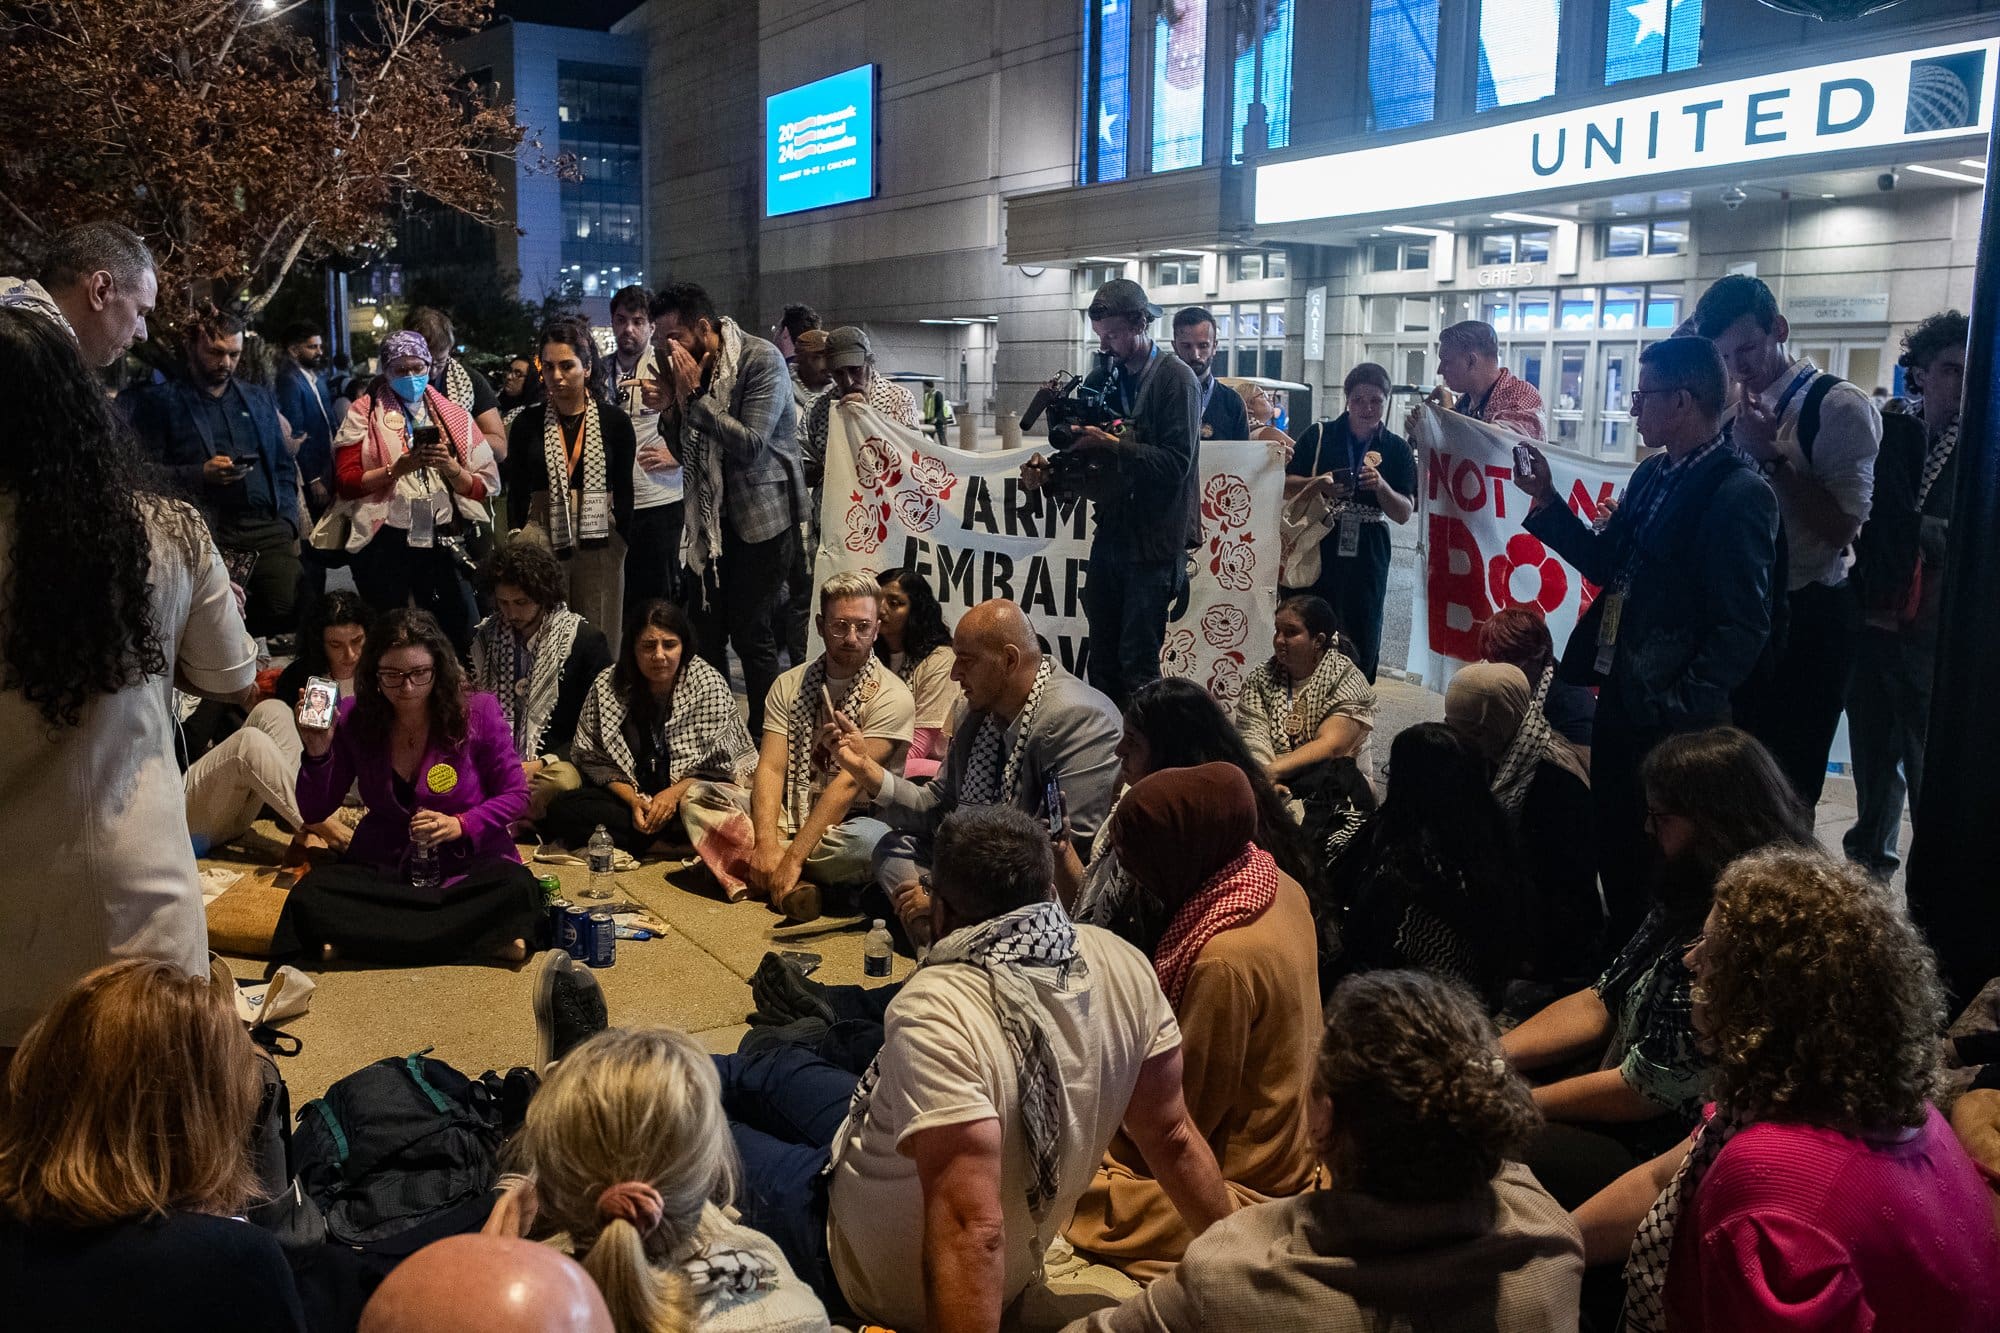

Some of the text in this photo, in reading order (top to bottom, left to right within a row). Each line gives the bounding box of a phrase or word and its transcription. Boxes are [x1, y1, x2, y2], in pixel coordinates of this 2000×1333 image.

[1532, 78, 1875, 176] UNITED
[1478, 267, 1534, 286] GATE 3
[1310, 294, 1321, 355] GATE 3
[961, 475, 1098, 541] ARM
[1429, 449, 1512, 518] NOT
[903, 536, 1191, 623] EMBAR
